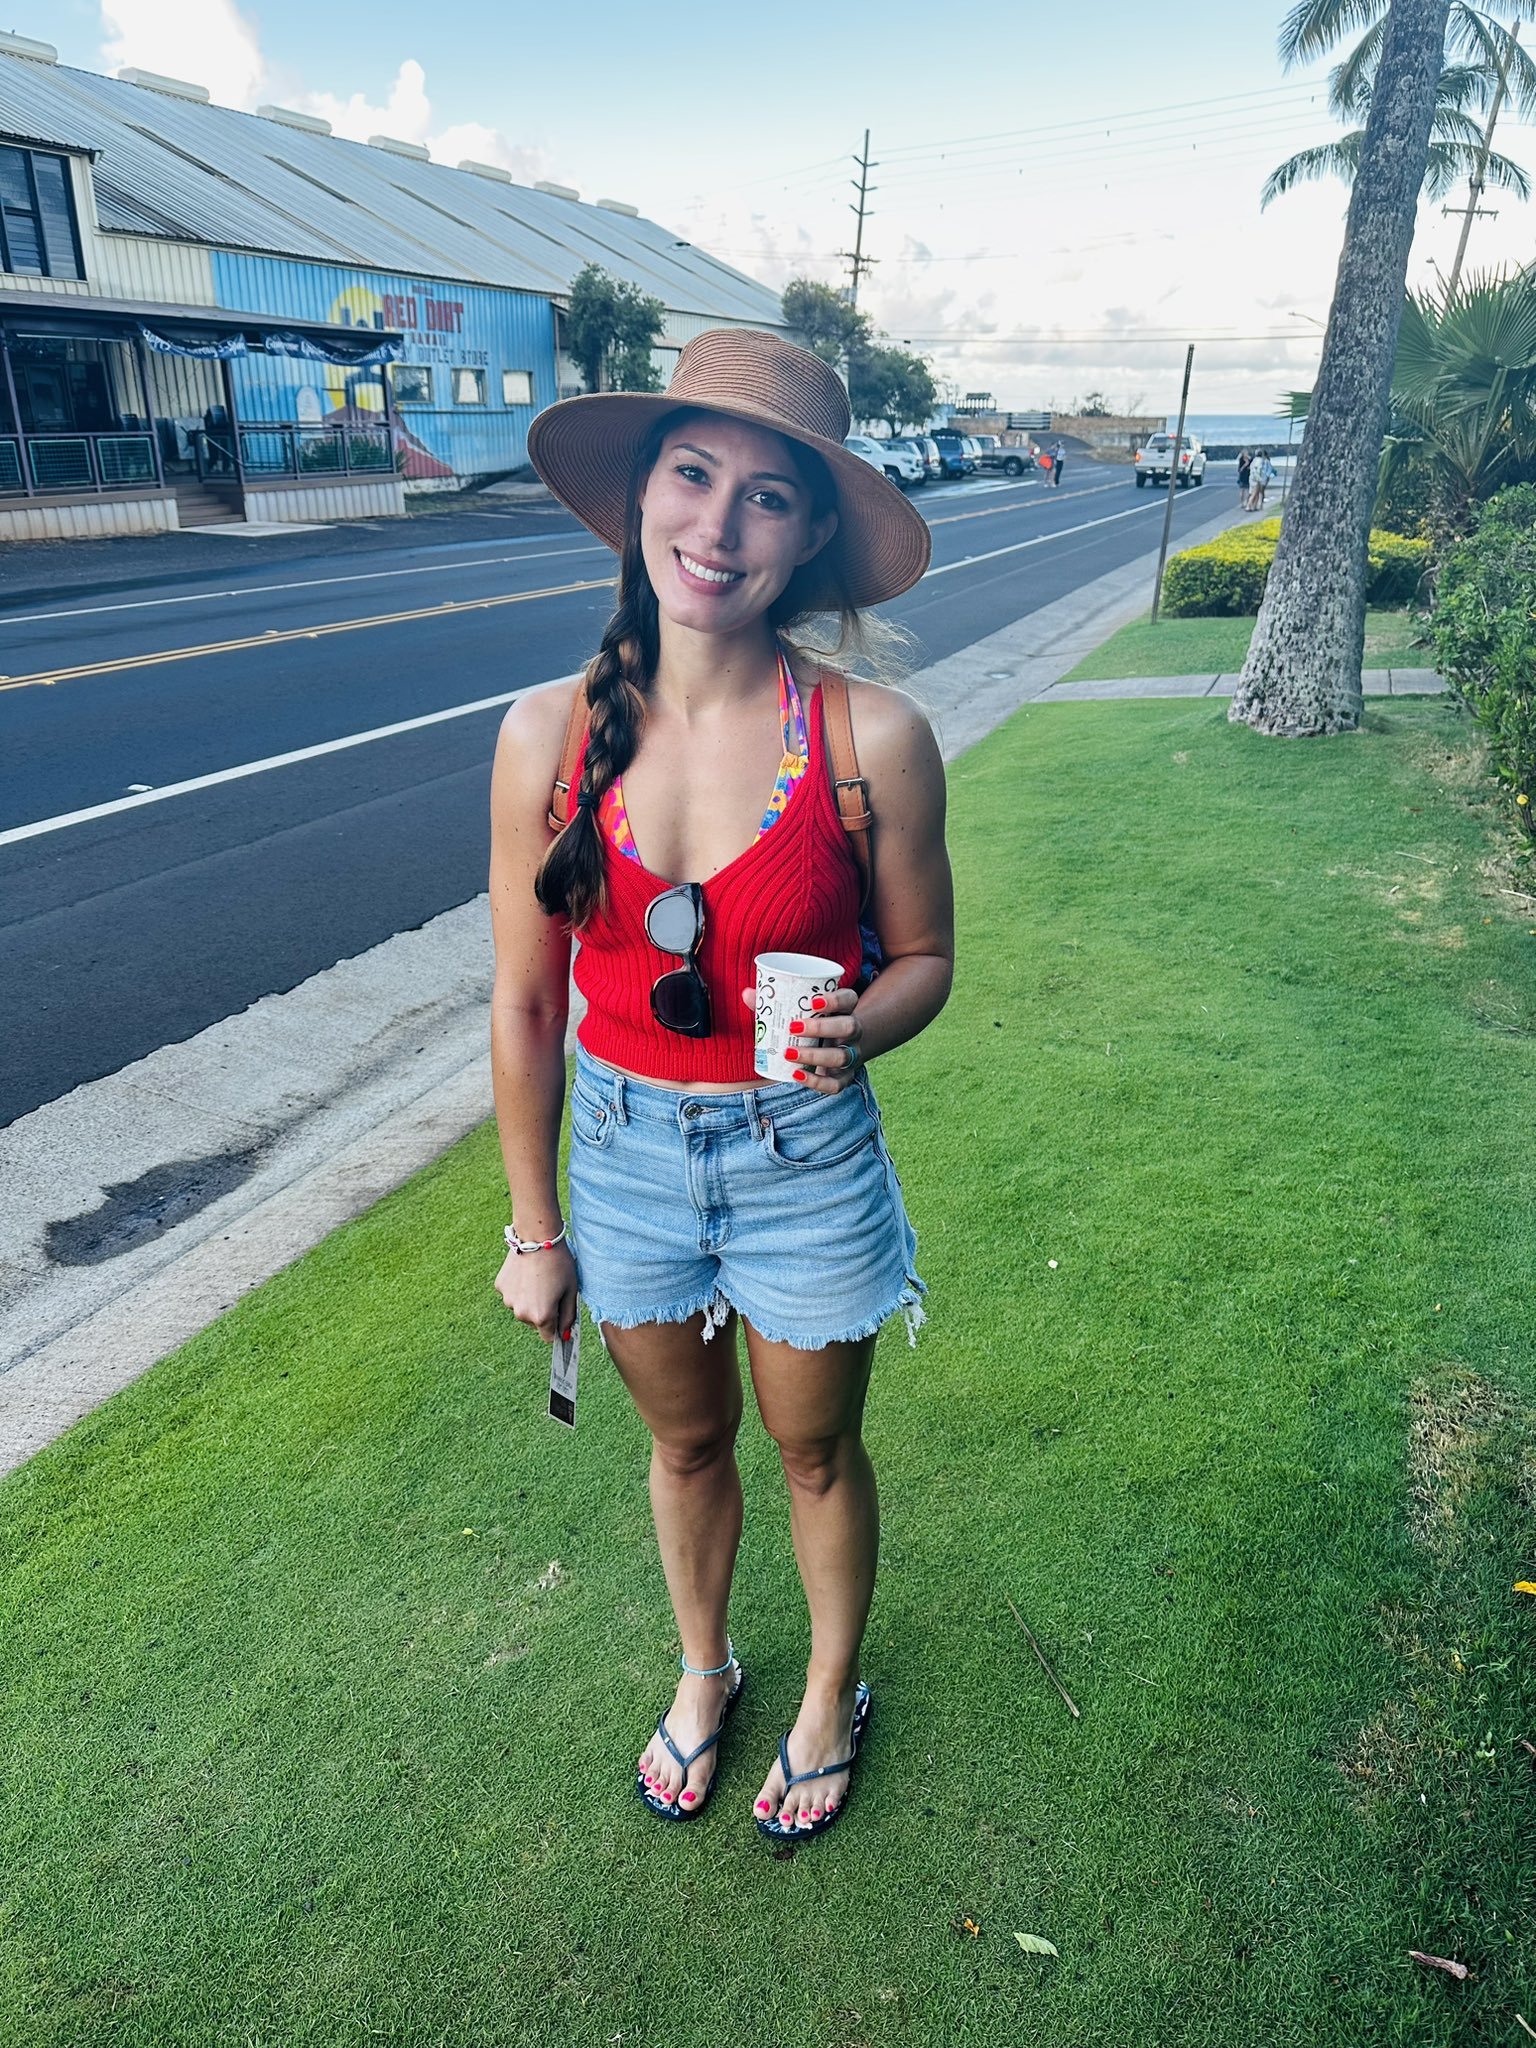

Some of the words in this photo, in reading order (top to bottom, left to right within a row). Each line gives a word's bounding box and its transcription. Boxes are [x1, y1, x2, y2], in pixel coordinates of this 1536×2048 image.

[383, 294, 417, 330] RED
[425, 298, 464, 334] DIRT
[419, 347, 454, 364] OUTLET
[461, 350, 489, 366] STORE
